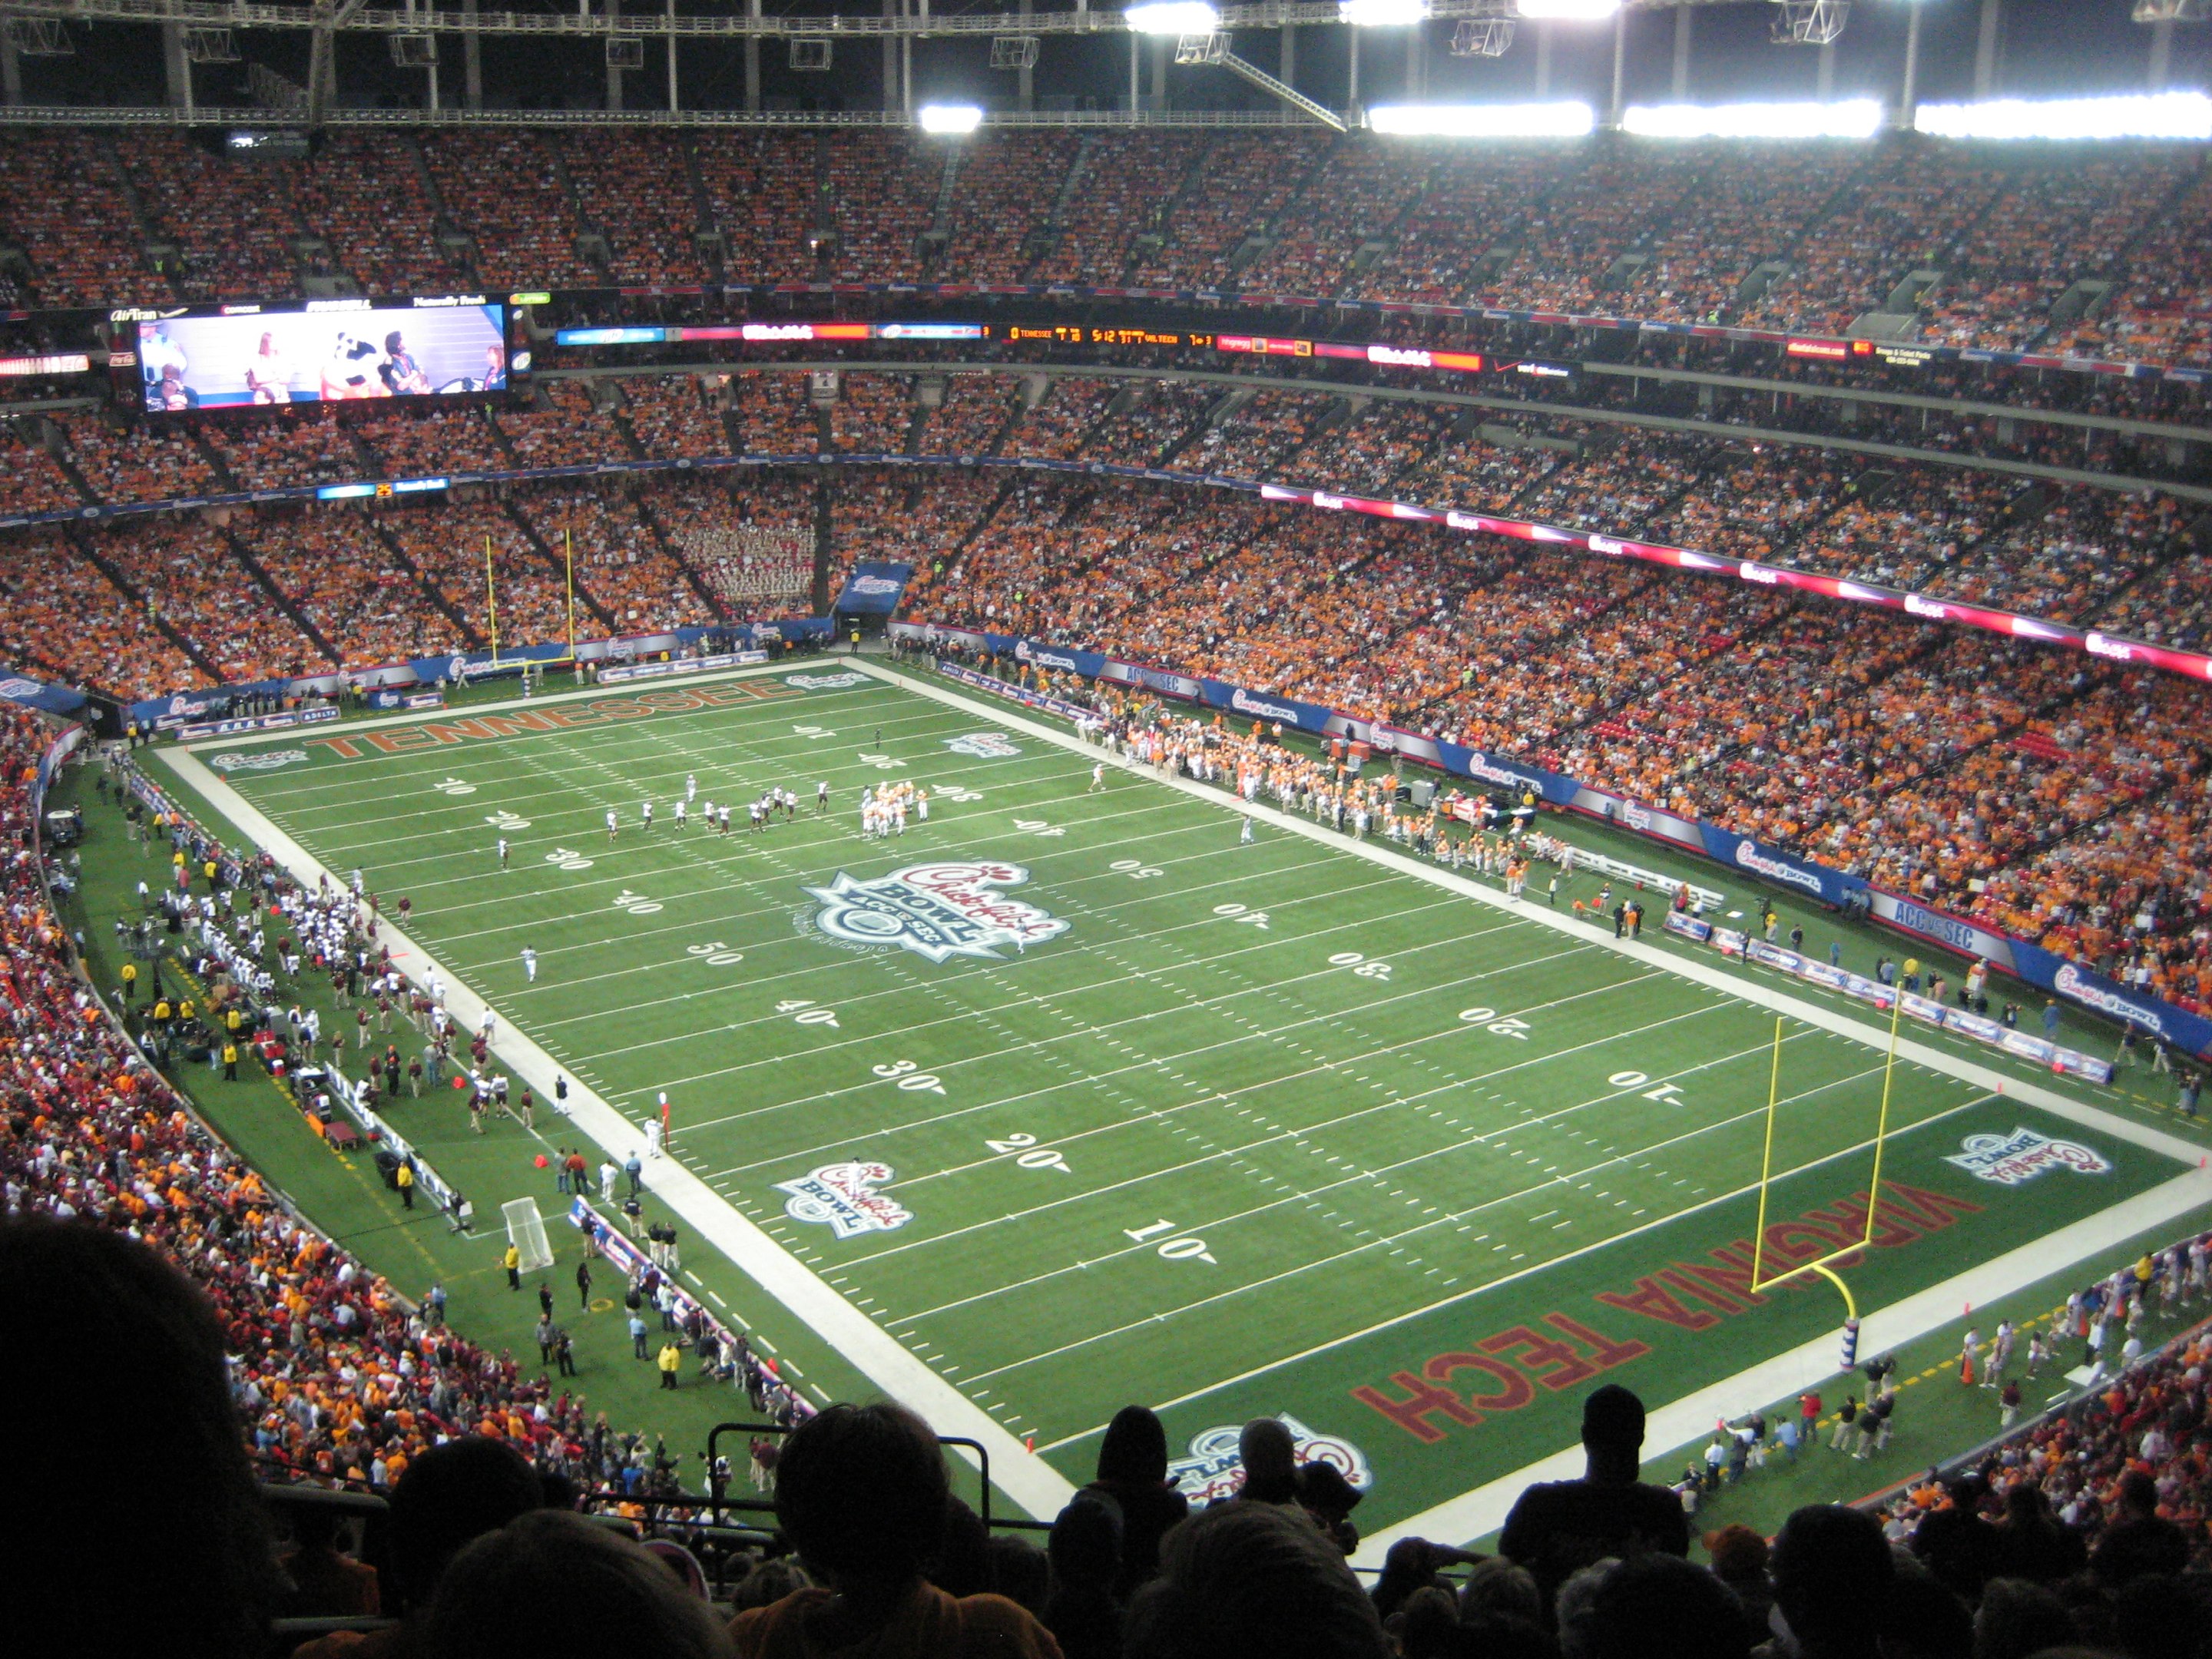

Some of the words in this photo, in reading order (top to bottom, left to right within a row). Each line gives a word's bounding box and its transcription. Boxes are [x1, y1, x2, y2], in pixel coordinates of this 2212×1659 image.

[1021, 329, 1052, 338] TENNESSEE
[1161, 674, 1179, 691] SEC
[302, 677, 806, 759] TENNESSEE
[435, 777, 478, 795] 10
[545, 850, 594, 870] 30
[1109, 859, 1165, 879] 50
[1786, 869, 1821, 892] BOWL
[613, 891, 664, 915] 40
[866, 883, 985, 942] BOWL
[902, 866, 1054, 936] Chick-filA
[1212, 902, 1269, 929] 40
[849, 896, 899, 912] ACC
[907, 920, 943, 942] SEC
[1895, 902, 1925, 931] ACC
[1945, 919, 1973, 949] SEC
[686, 941, 743, 965] 50
[1327, 952, 1392, 979] 30
[774, 998, 836, 1025] 40
[1457, 1007, 1531, 1038] 20
[2117, 1003, 2158, 1026] BOWL
[872, 1059, 941, 1091] 30
[1608, 1071, 1684, 1103] 10
[985, 1132, 1064, 1169] 20
[1964, 1134, 2043, 1165] BOWL
[796, 1180, 864, 1230] BOWL
[1123, 1217, 1208, 1260] 10
[1593, 1178, 1986, 1333] VIRGINIA
[1349, 1310, 1653, 1445] TECH
